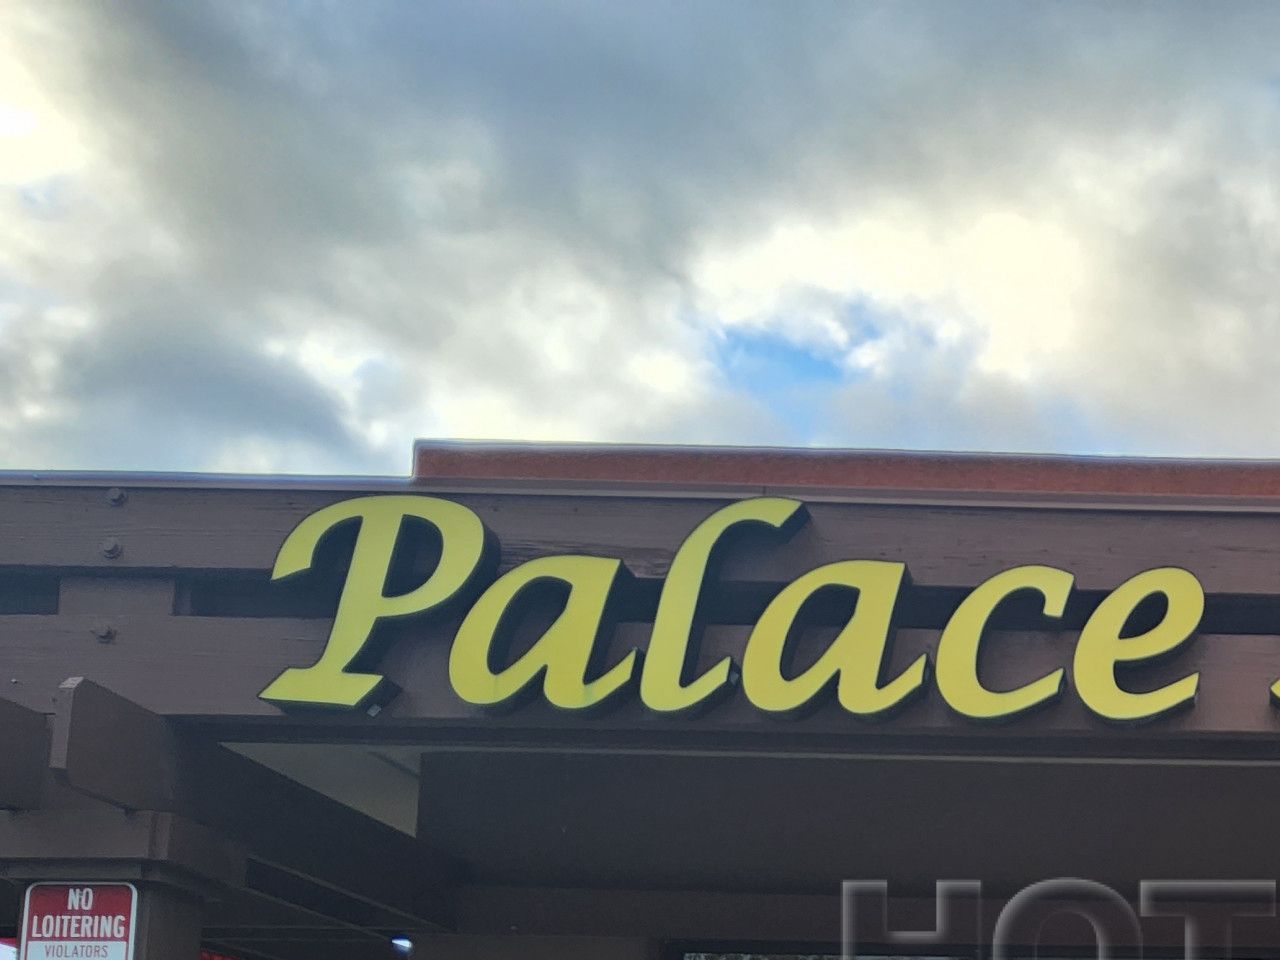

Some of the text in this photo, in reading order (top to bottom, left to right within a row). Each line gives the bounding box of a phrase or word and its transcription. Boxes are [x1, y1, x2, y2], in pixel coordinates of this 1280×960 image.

[257, 496, 1206, 721] Palace
[67, 888, 94, 910] NO
[31, 915, 126, 938] LOITERING
[44, 945, 109, 958] VIOLATORS
